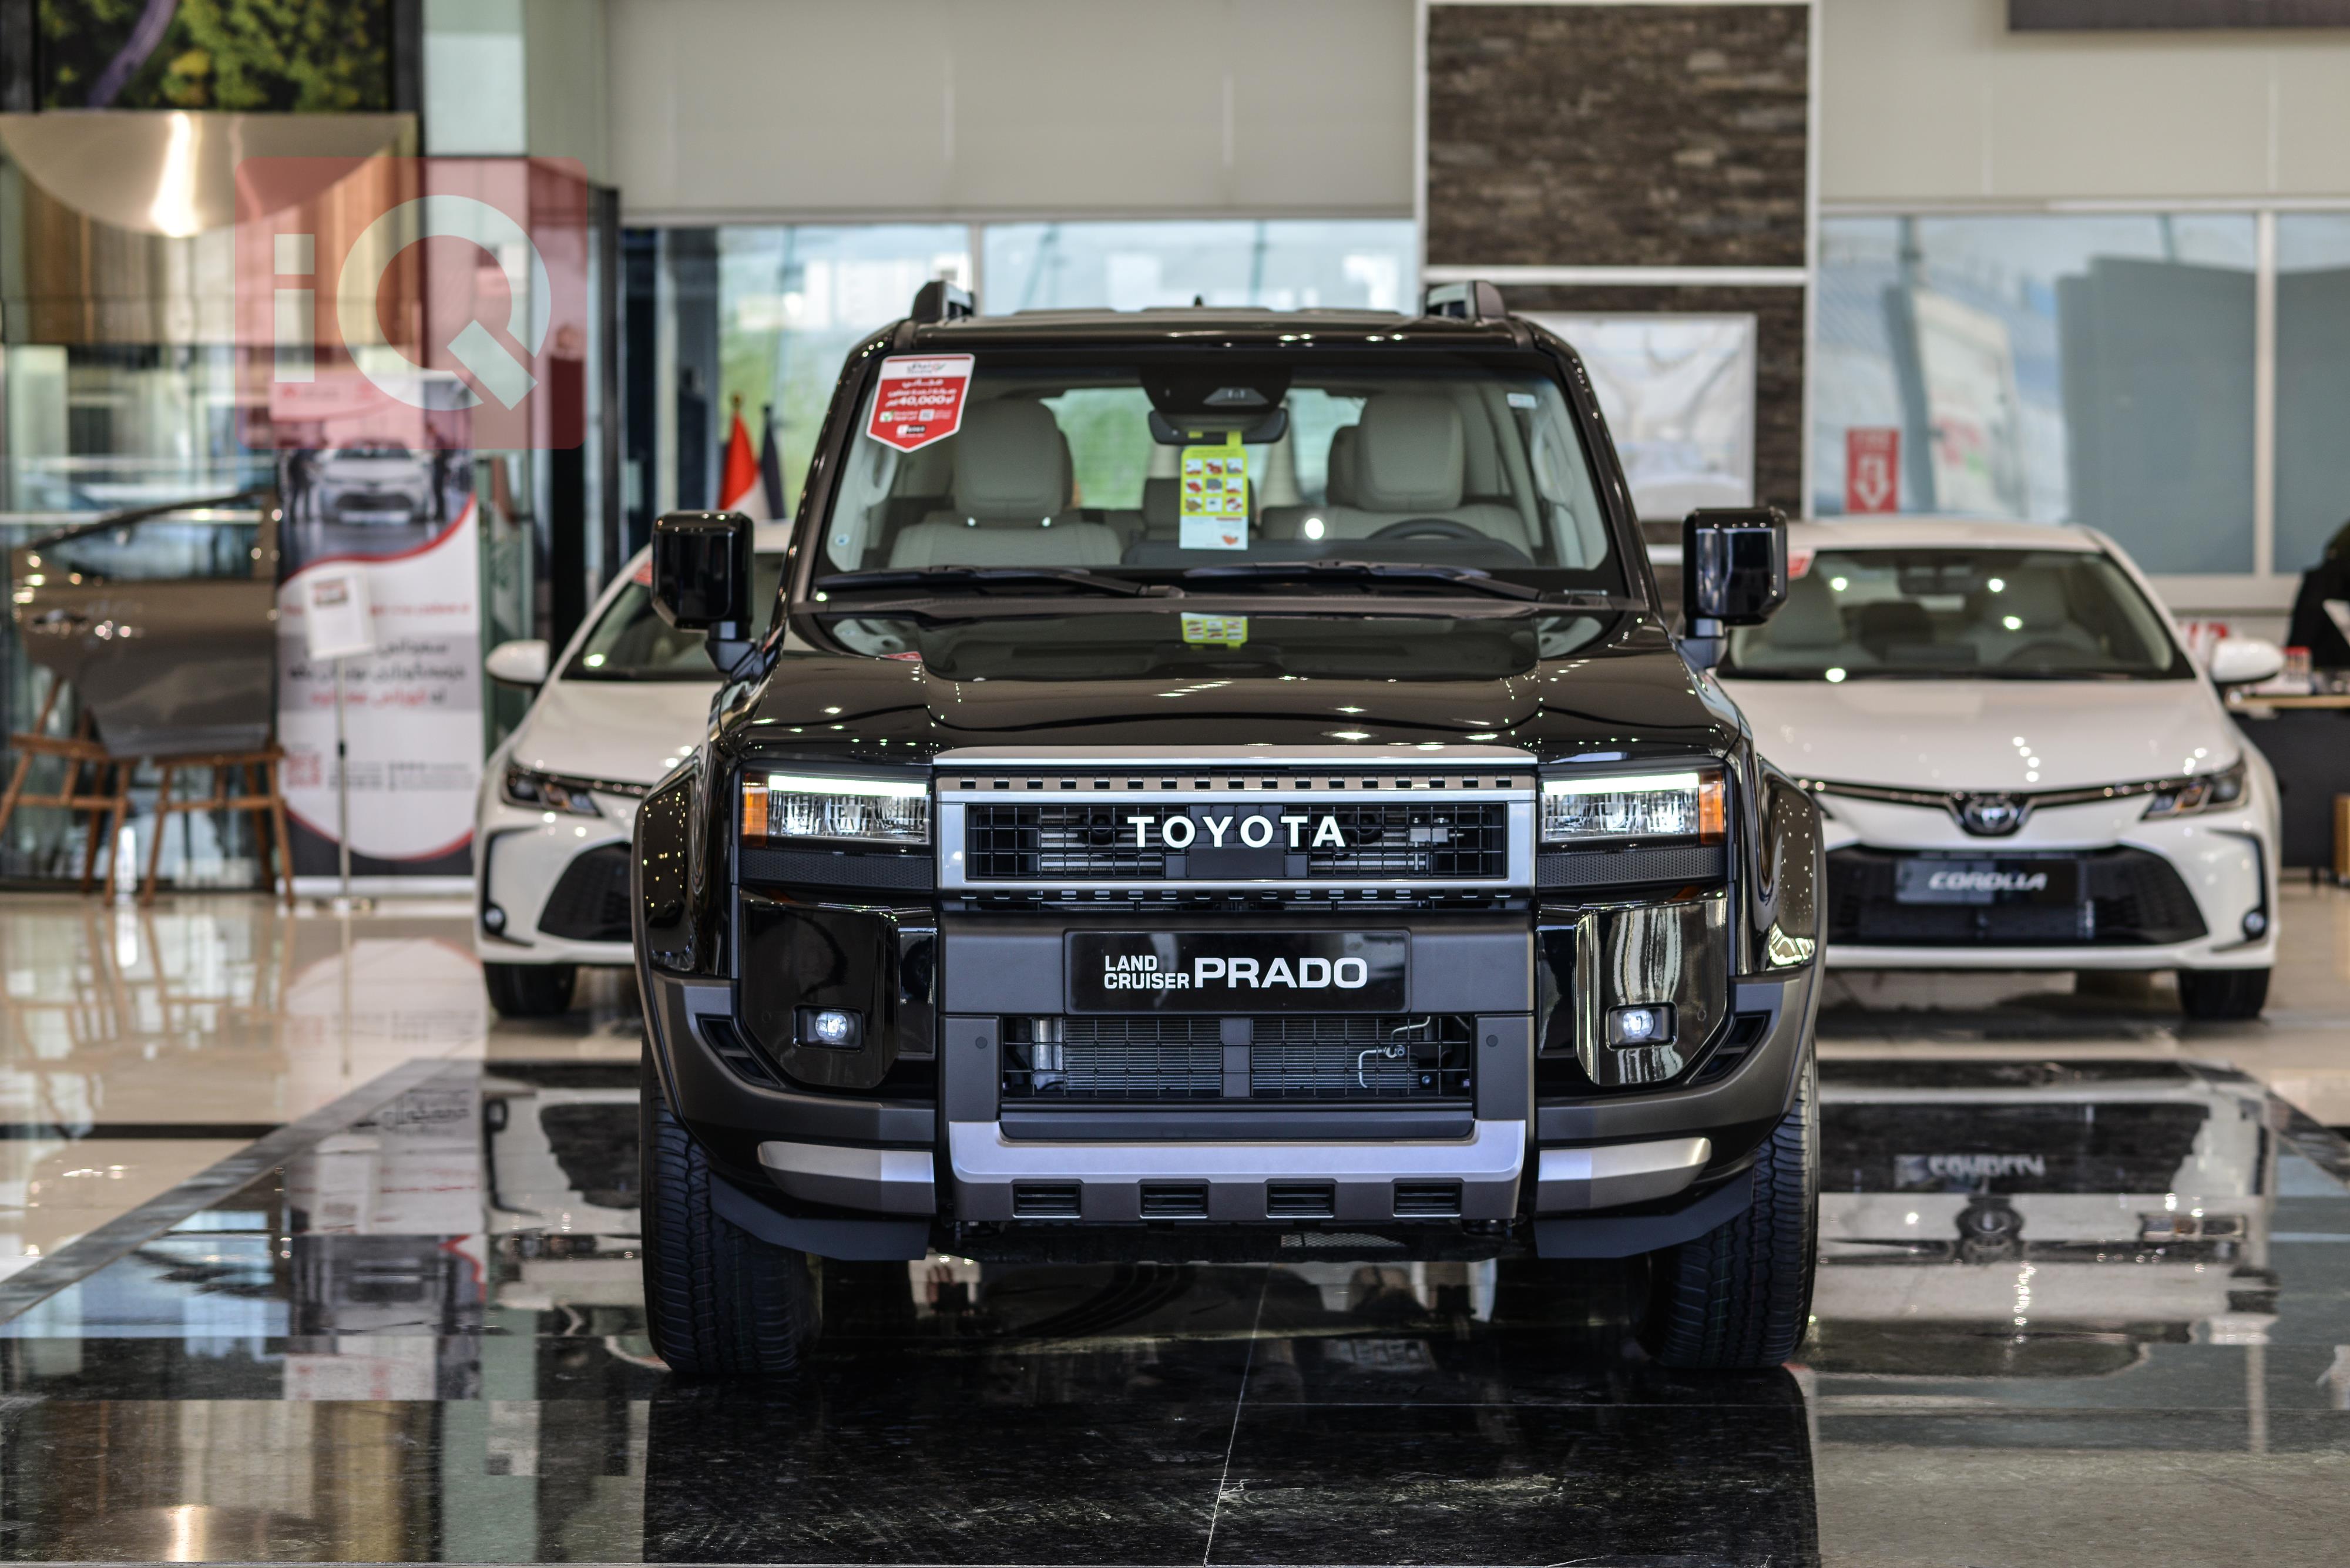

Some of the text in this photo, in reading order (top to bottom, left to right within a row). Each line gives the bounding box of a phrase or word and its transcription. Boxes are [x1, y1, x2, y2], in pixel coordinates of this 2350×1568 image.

[1127, 815, 1346, 848] TOYOTA
[1928, 871, 2048, 891] COROLLA
[1104, 955, 1157, 971] LAND
[1194, 957, 1368, 989] PRADO
[1104, 972, 1190, 989] CRUISER
